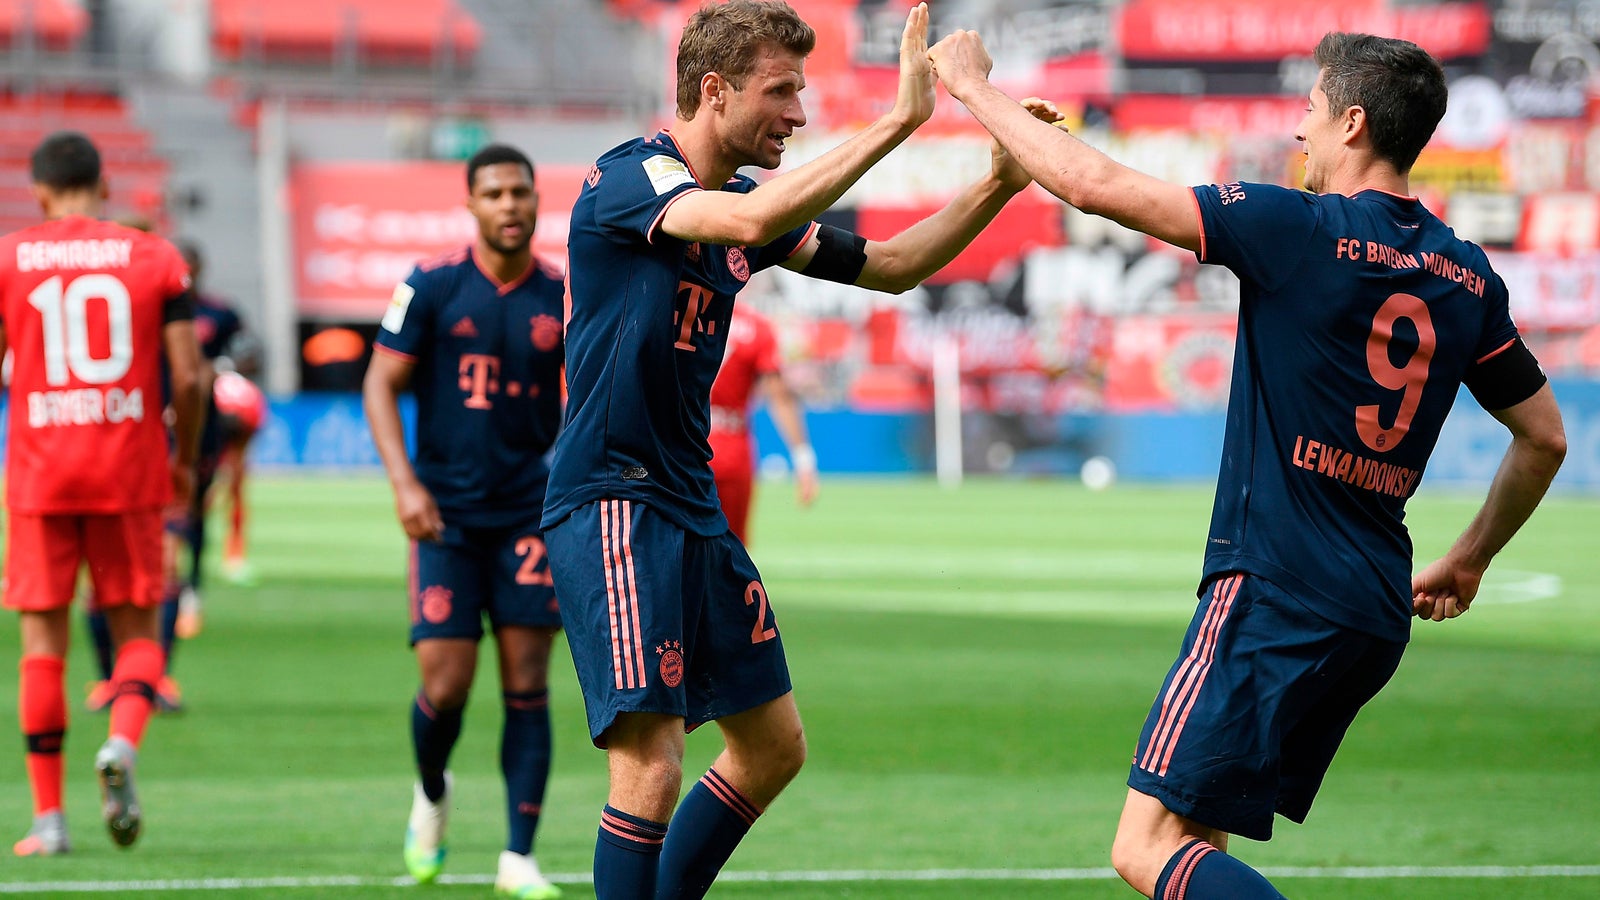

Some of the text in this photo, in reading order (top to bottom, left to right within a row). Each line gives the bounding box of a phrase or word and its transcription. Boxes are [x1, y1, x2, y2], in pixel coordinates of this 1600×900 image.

[1336, 238, 1486, 298] FC BAYERN MÜNCHEN
[27, 273, 134, 386] 10
[1355, 292, 1437, 453] 9
[27, 386, 144, 428] BAYER 04
